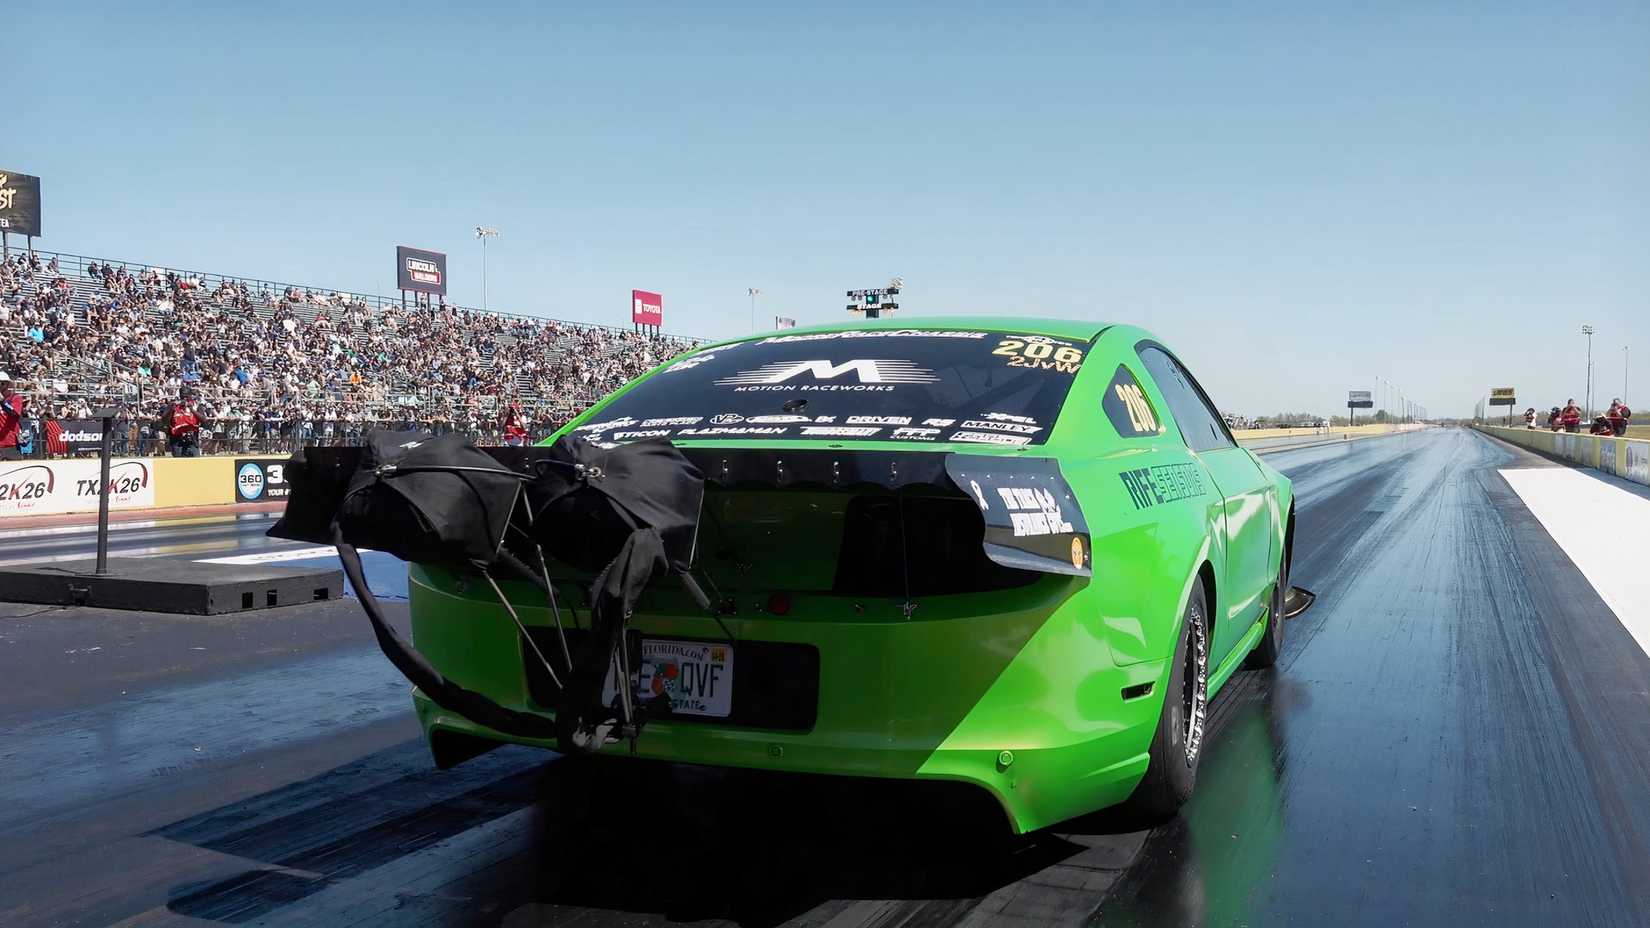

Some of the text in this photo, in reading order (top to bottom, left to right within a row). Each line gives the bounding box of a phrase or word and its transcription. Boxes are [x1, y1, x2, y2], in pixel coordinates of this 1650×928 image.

[642, 303, 661, 314] TOYOTA
[992, 340, 1083, 363] 206
[734, 384, 896, 392] MOTION RACEWORKS
[1115, 384, 1157, 432] 206
[846, 416, 913, 425] DRIVEN
[964, 421, 1032, 432] MANLEY
[240, 474, 262, 484] 360
[76, 476, 141, 497] TXK26
[1119, 467, 1164, 510] RIFE
[267, 488, 285, 497] YOUR
[681, 662, 724, 698] QVF
